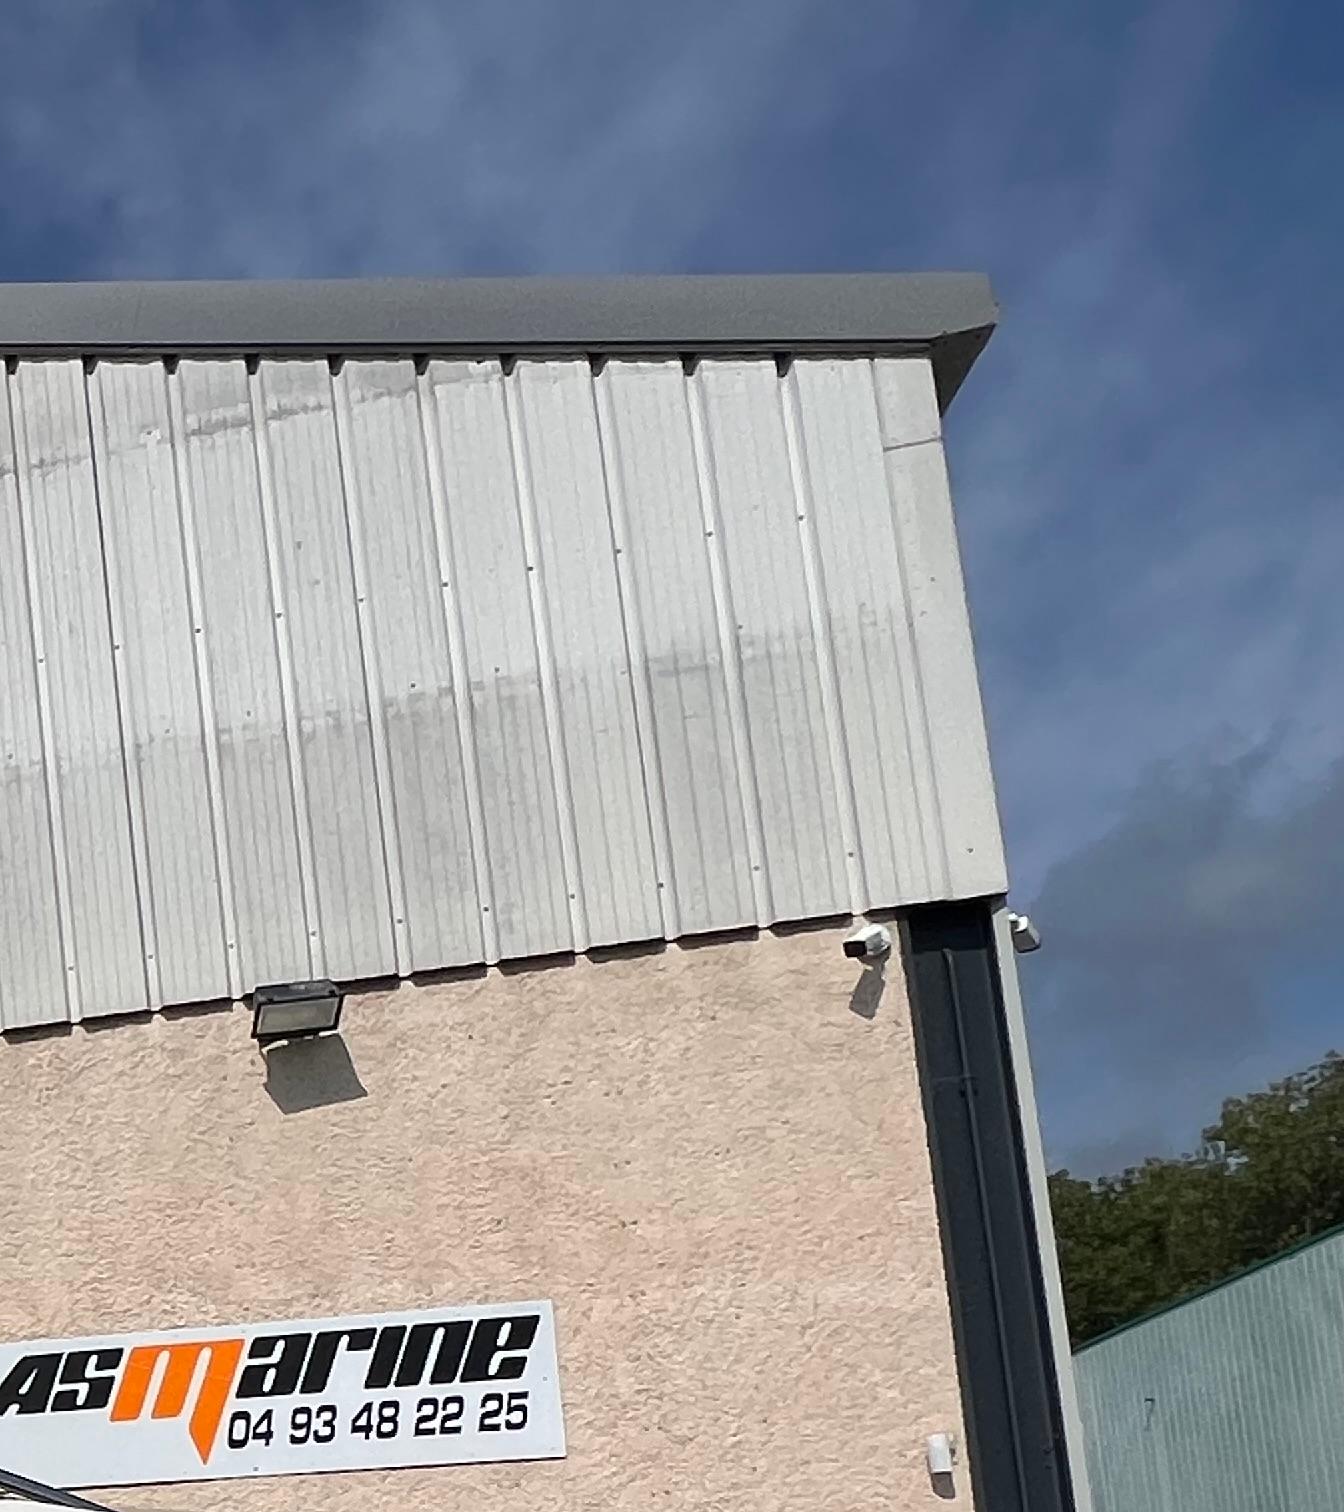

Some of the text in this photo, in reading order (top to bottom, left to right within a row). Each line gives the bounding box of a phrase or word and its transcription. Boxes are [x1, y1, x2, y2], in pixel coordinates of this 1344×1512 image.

[227, 1390, 530, 1449] 04 93 48 22 25
